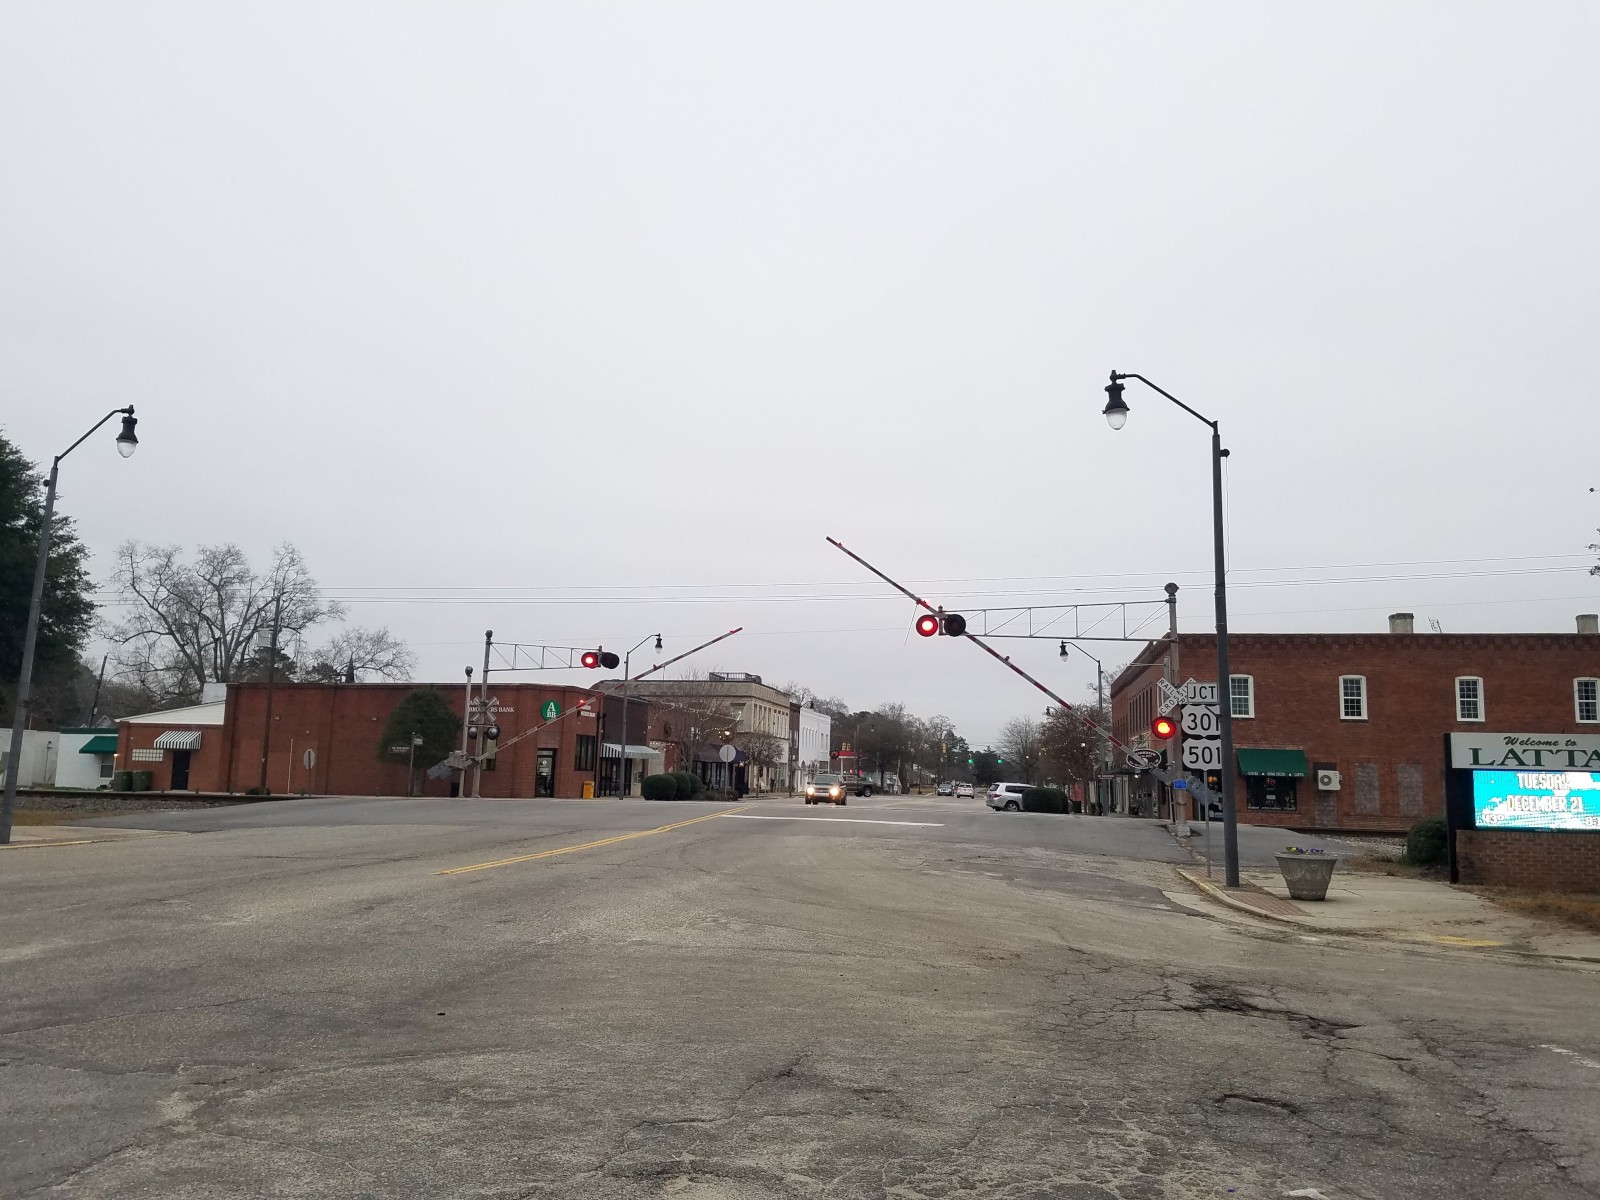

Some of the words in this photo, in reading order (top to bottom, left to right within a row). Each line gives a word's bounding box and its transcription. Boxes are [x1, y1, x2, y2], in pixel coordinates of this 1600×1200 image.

[1189, 686, 1216, 699] JCT
[1187, 712, 1220, 731] 301
[1503, 736, 1559, 746] Welcome
[1565, 739, 1577, 747] to
[1189, 746, 1221, 765] 501
[1506, 795, 1567, 812] DECEMBER
[1569, 797, 1583, 812] 21
